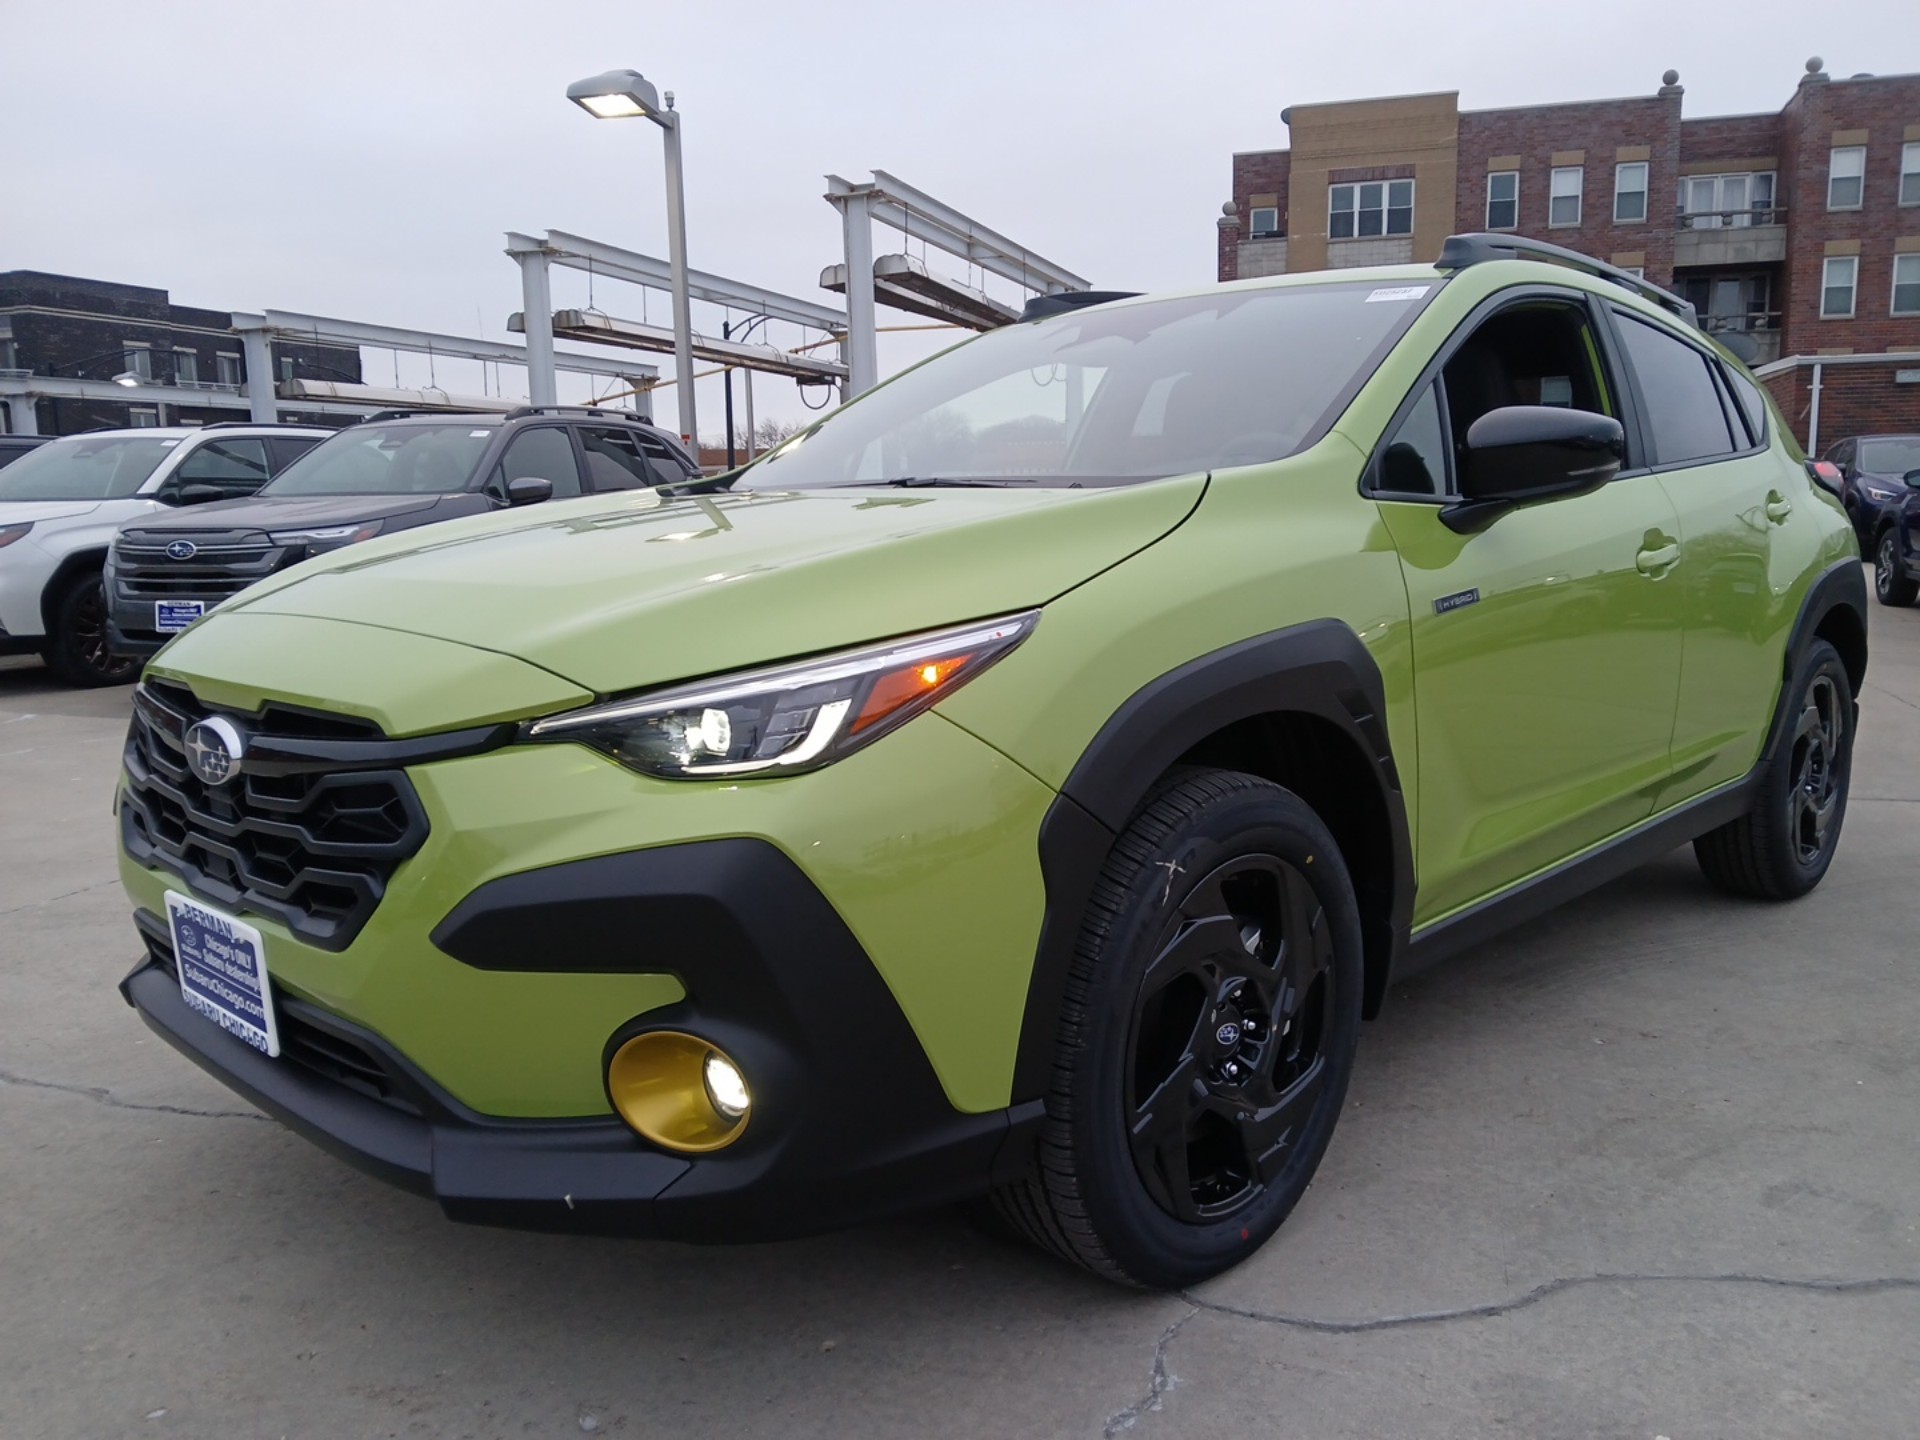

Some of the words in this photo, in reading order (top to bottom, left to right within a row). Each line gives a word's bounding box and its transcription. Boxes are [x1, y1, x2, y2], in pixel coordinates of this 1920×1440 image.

[1443, 593, 1473, 608] HYBRID
[184, 903, 232, 939] BERMAN
[185, 964, 264, 1019] SubaruChicago.com
[184, 989, 219, 1022] SUBARU
[222, 1012, 268, 1053] CHICAGO
